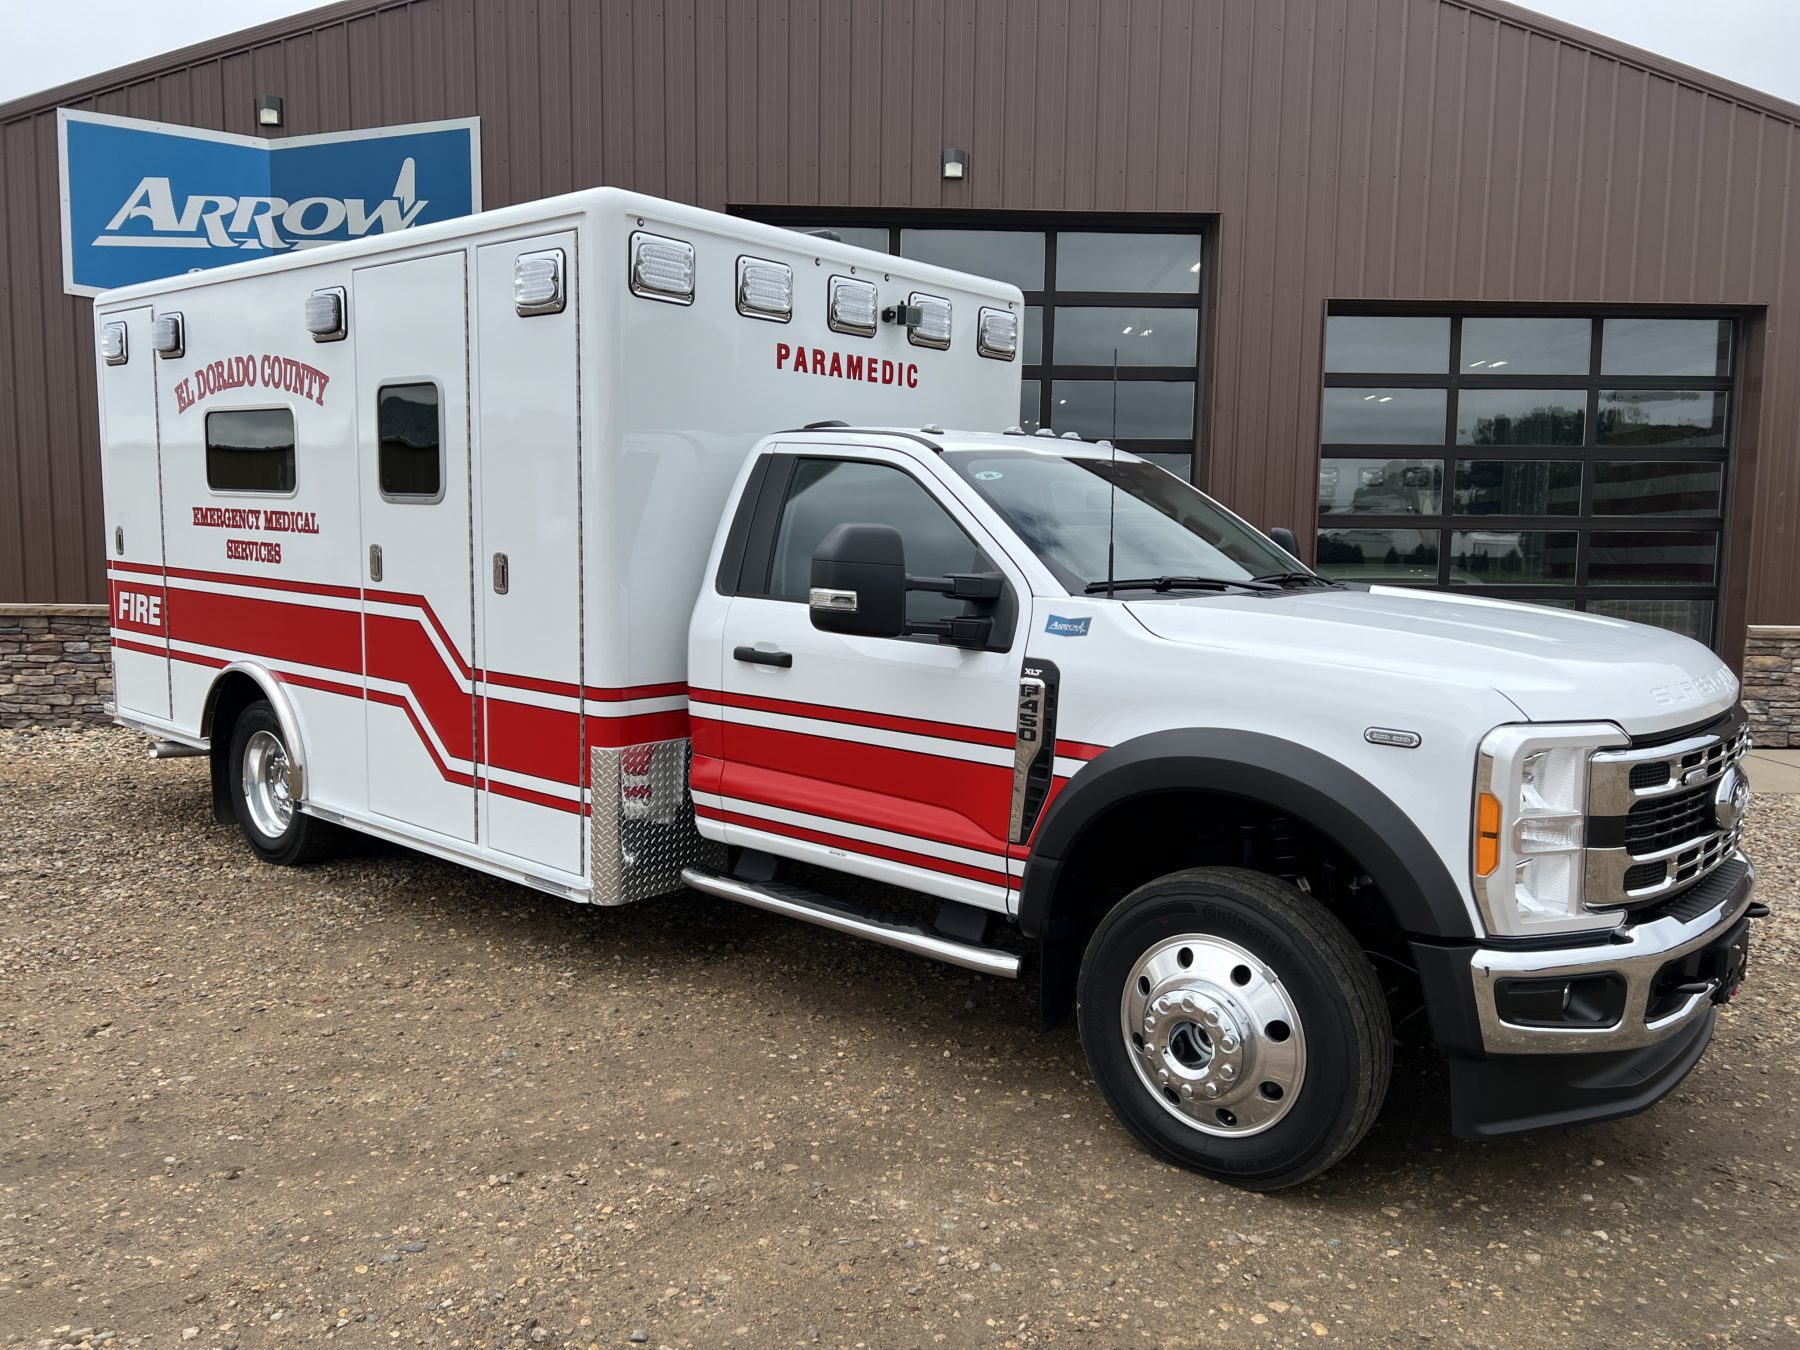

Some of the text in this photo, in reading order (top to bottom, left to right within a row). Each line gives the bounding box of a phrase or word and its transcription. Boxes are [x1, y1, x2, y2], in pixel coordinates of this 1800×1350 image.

[104, 176, 429, 249] ARROW
[776, 342, 918, 389] PARAMEDIC
[174, 354, 330, 415] EL DORADO COUNTY
[192, 506, 320, 534] EMERGENCY MEDICAL
[226, 539, 282, 564] SERVICES
[118, 591, 161, 627] FIRE
[1024, 667, 1043, 677] XLT
